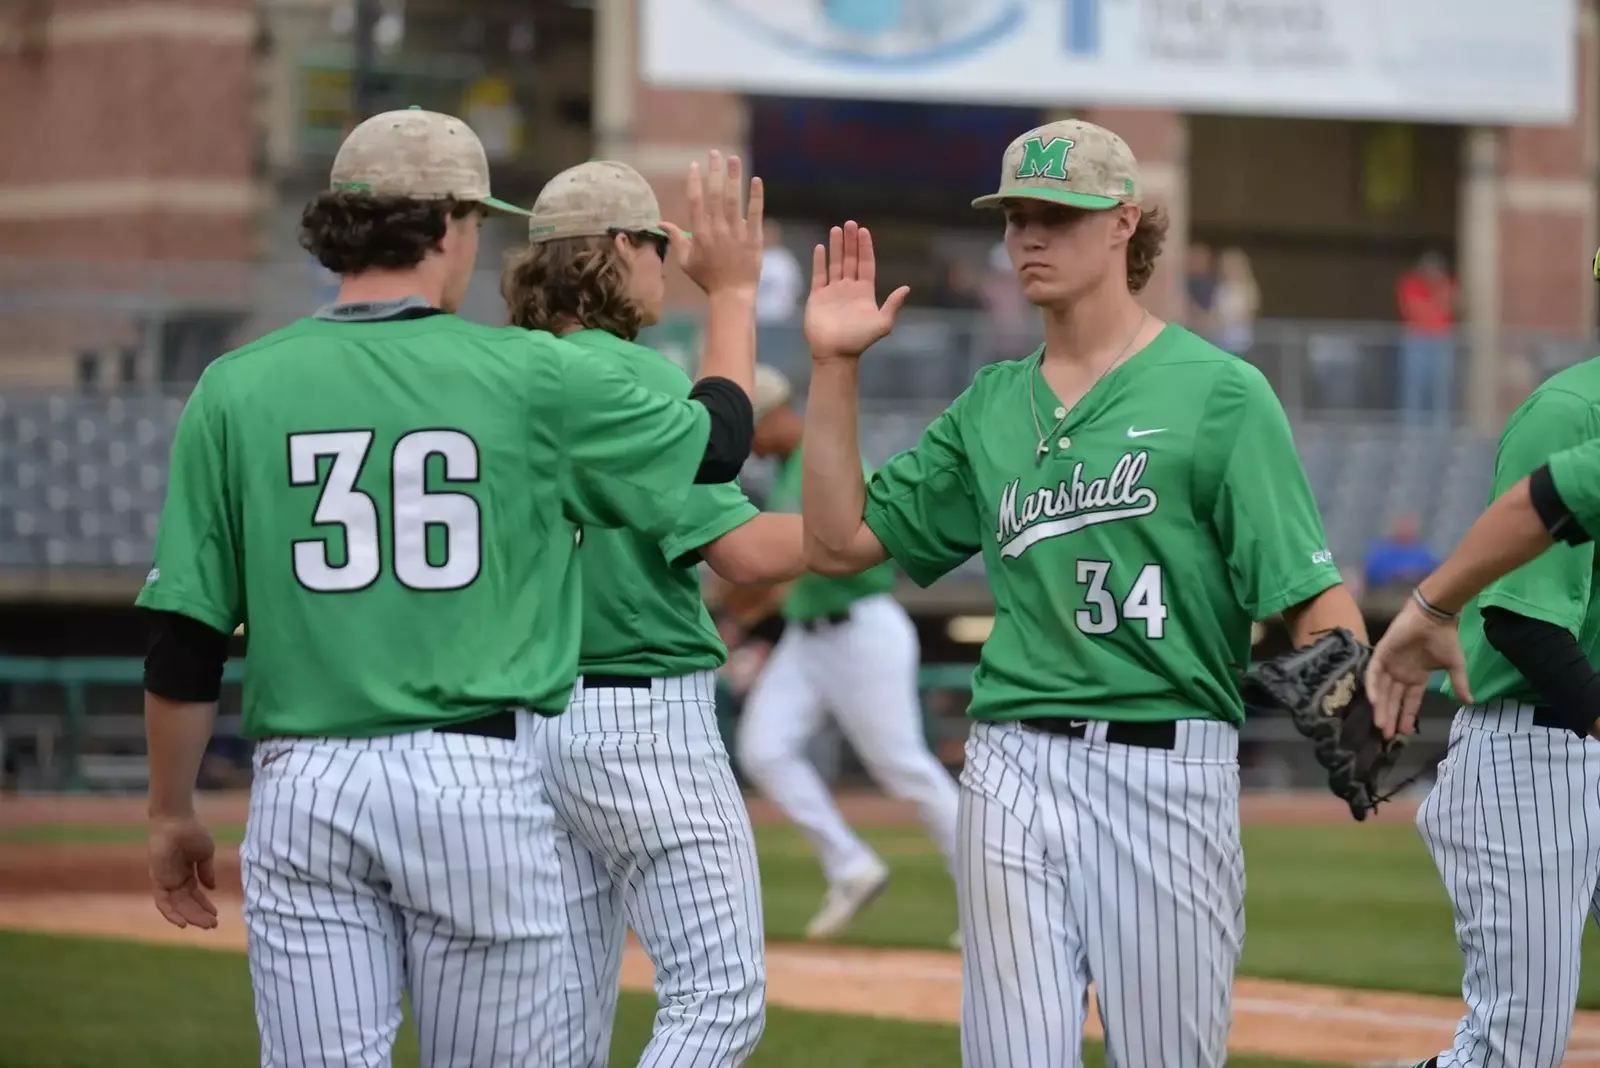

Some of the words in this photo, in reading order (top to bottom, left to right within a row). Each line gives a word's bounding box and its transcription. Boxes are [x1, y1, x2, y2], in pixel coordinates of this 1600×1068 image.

[1015, 136, 1075, 181] M
[286, 427, 482, 594] 36
[996, 450, 1158, 545] Marshall
[1074, 558, 1168, 639] 34
